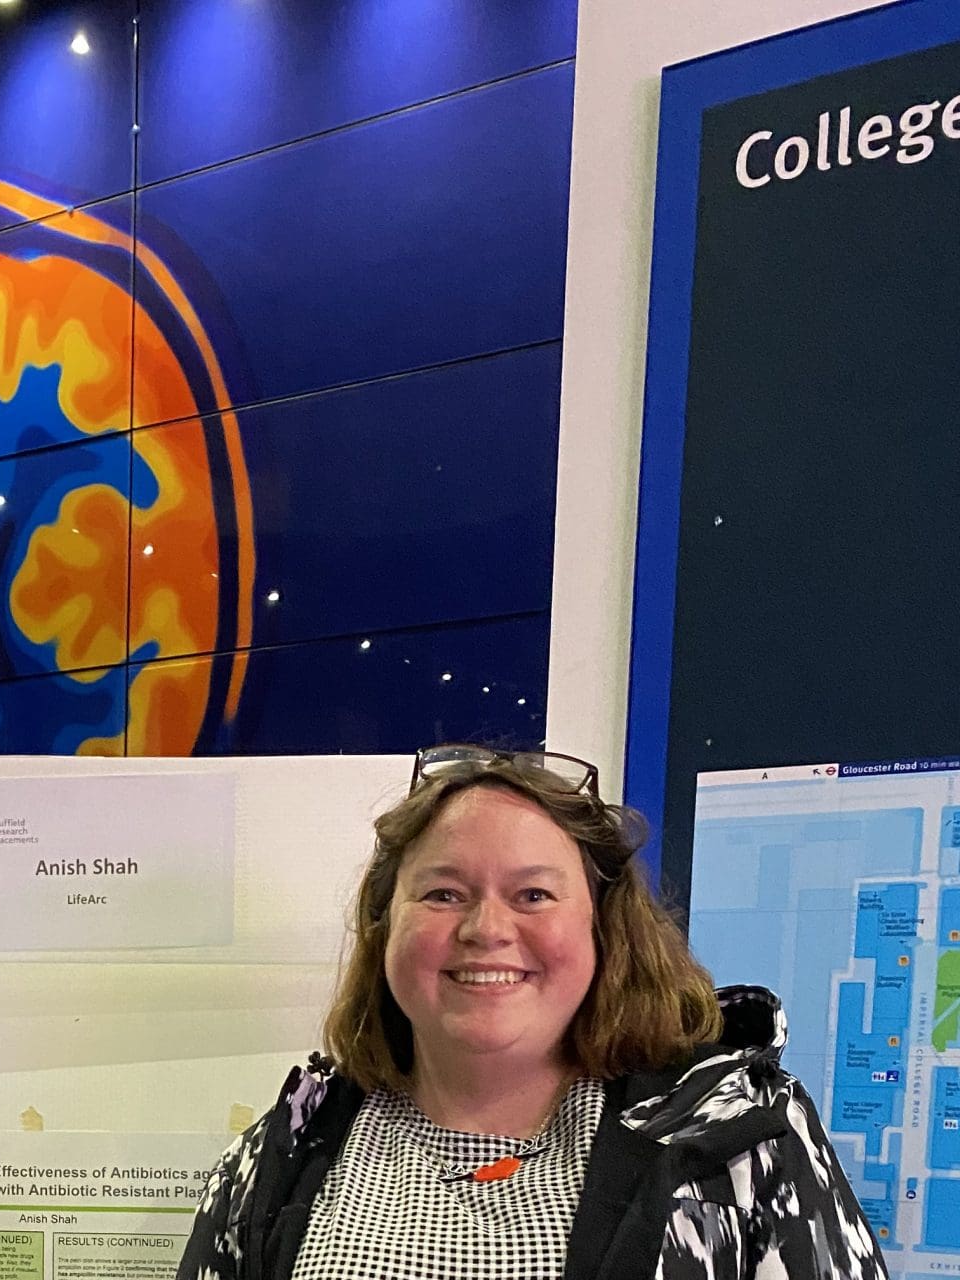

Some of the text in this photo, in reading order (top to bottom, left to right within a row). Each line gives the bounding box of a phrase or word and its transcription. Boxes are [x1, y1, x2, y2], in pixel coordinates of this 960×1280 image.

[843, 763, 891, 775] Gloucester
[894, 762, 917, 771] Road
[931, 761, 946, 769] min
[762, 772, 768, 780] A
[35, 857, 138, 876] Anish Shah
[67, 894, 107, 905] LifeArc
[913, 1048, 923, 1094] COLLEGE
[911, 1100, 920, 1128] ROAD
[92, 1167, 107, 1178] of
[111, 1166, 188, 1180] Antibiotics
[193, 1169, 210, 1183] ag
[29, 1184, 97, 1197] Antibiotic
[102, 1185, 169, 1198] Resistant
[174, 1186, 203, 1198] Plas
[19, 1213, 77, 1224] Anish Shah
[58, 1237, 174, 1249] RESULTS (CONTINUED)
